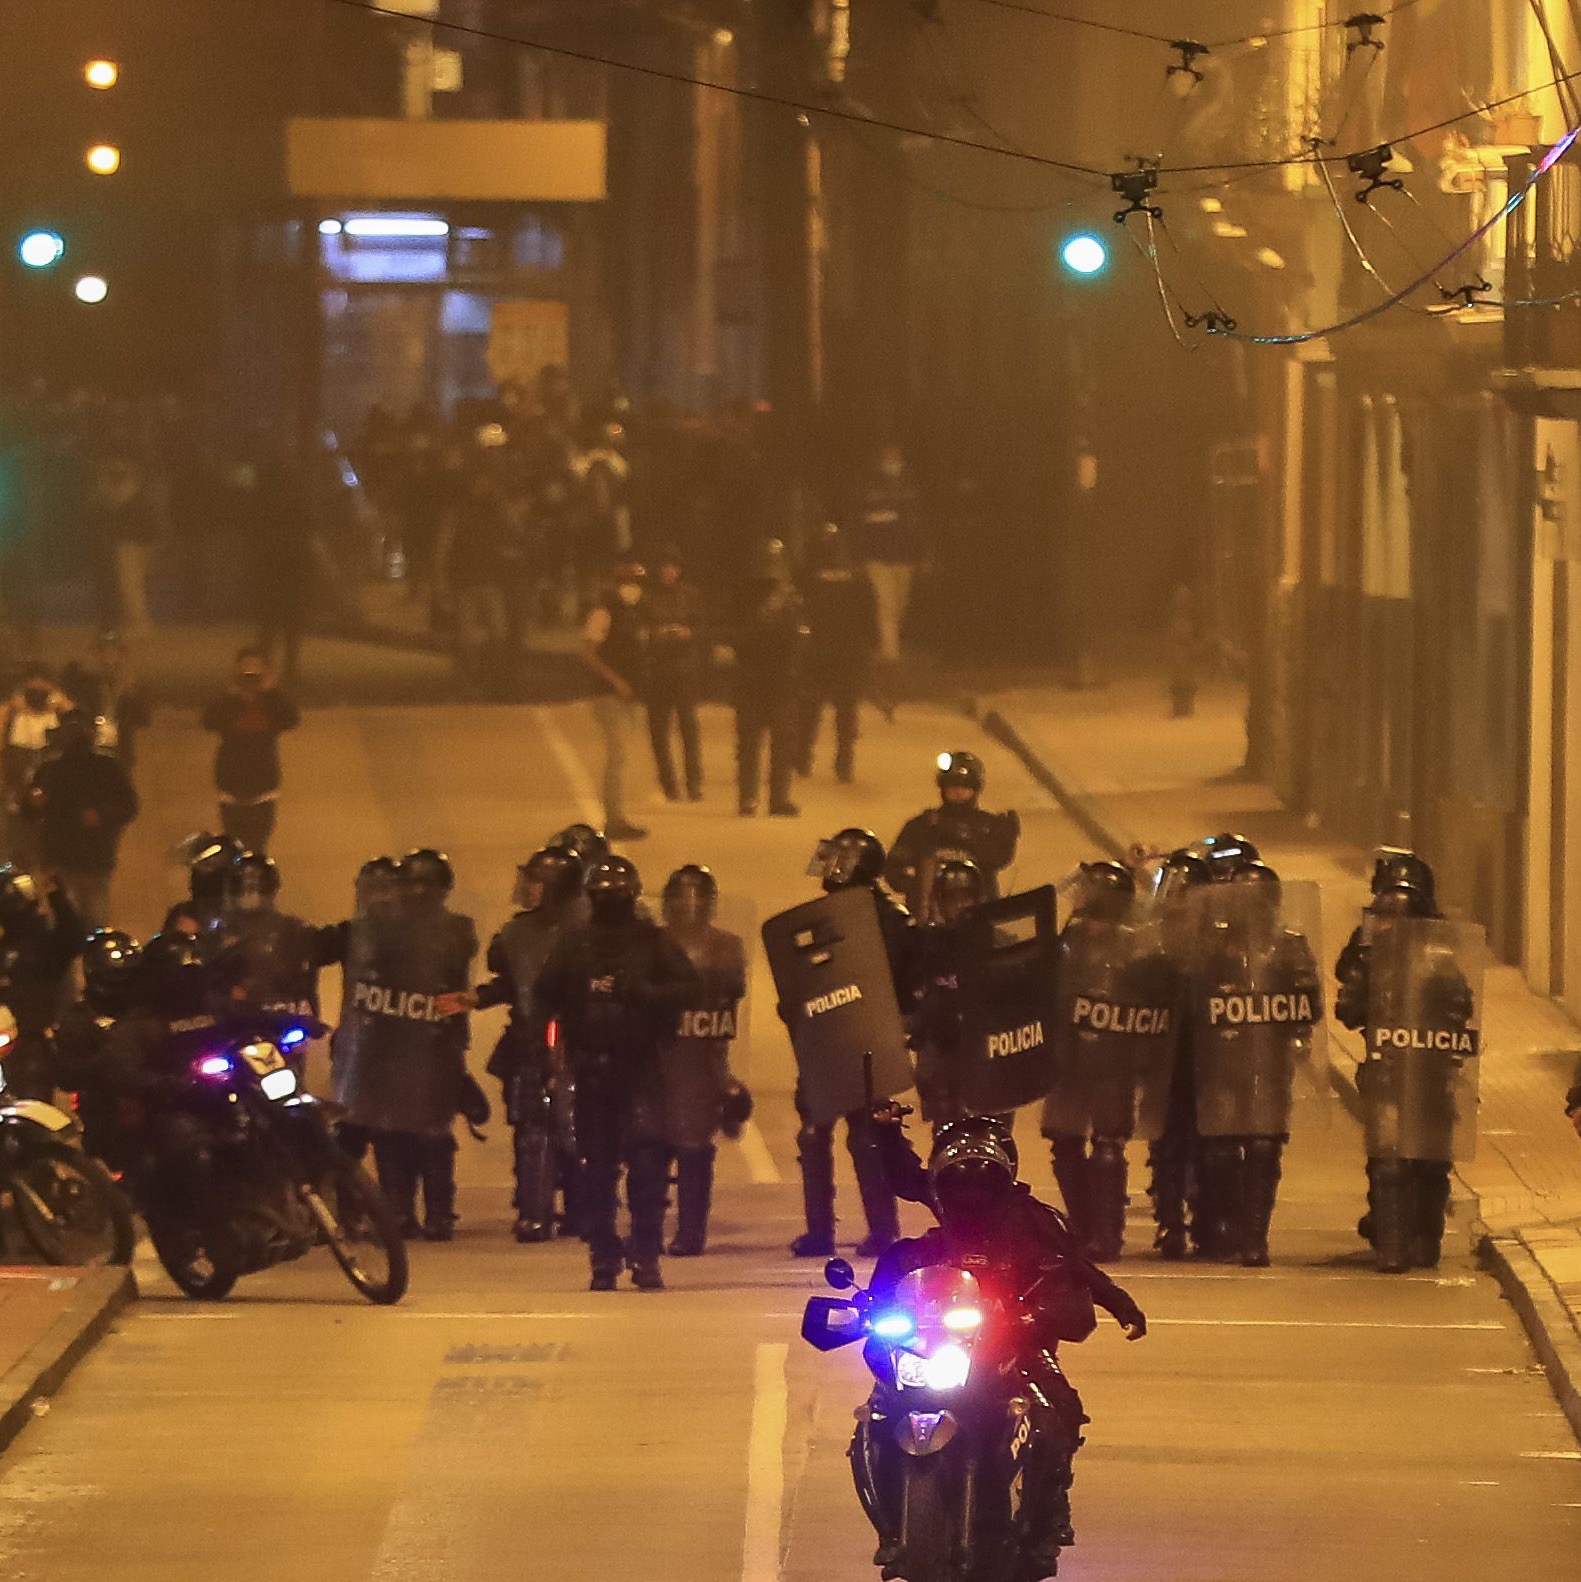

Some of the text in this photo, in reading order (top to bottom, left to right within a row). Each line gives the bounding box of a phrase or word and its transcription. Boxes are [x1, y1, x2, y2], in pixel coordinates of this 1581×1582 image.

[353, 981, 441, 1022] POLICI
[805, 984, 863, 1017] POLICIA
[1073, 997, 1170, 1034] POLICIA
[1209, 993, 1313, 1024] POLICIA
[988, 1021, 1044, 1058] POLICIA
[1376, 1028, 1472, 1052] POLICIA
